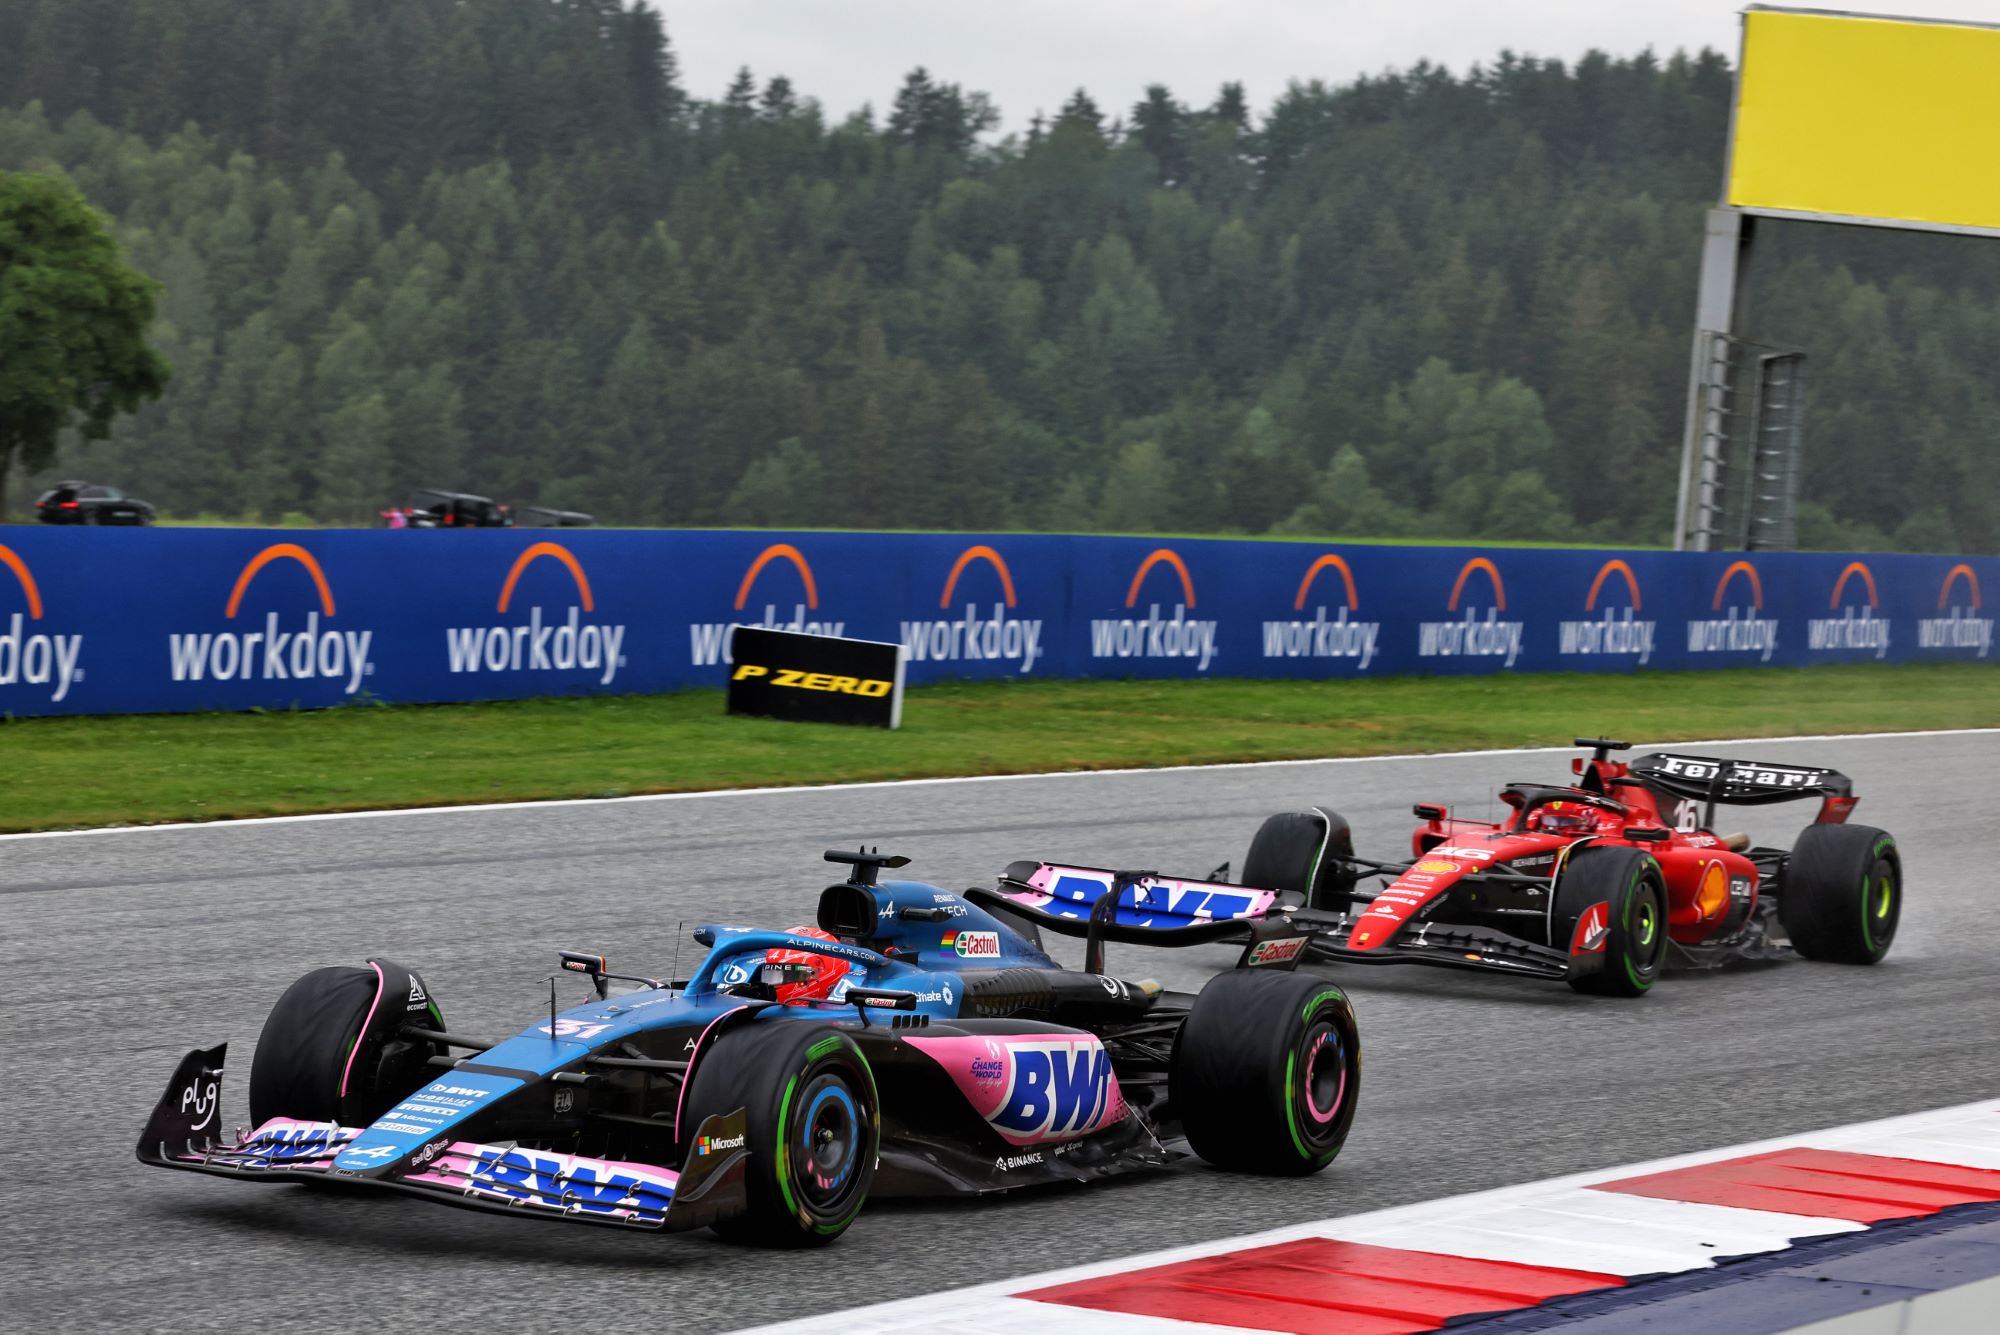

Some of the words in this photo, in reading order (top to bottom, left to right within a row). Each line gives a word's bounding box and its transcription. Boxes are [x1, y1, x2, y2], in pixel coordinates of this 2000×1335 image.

[448, 607, 624, 684] workday
[901, 603, 1041, 673] workday
[1092, 604, 1216, 670] workday
[1264, 607, 1379, 668] workday
[1420, 608, 1522, 667] workday
[1560, 607, 1655, 664] workday
[1688, 607, 1778, 661] workday
[1808, 606, 1890, 658] workday
[1919, 606, 1994, 657] workday
[170, 612, 373, 693] workday
[732, 664, 768, 680] P
[769, 668, 893, 697] ZERO
[1674, 799, 1698, 834] 16
[786, 938, 876, 962] ALPINECARS.COM
[967, 934, 999, 955] Castrol
[1260, 940, 1298, 962] Castrol
[871, 997, 896, 1007] Castrol
[538, 1018, 615, 1039] 31
[971, 1061, 1003, 1071] CHANGE
[975, 1071, 1002, 1079] WORLD
[181, 1077, 218, 1131] plug
[444, 1086, 490, 1098] BWT
[988, 1047, 1112, 1133] BWT
[401, 1113, 445, 1125] Microsoft
[411, 1154, 424, 1167] Bell
[433, 1138, 449, 1153] Ross
[710, 1133, 745, 1151] Microsoft
[1007, 1152, 1044, 1169] BINANCE
[467, 1149, 677, 1221] BWT
